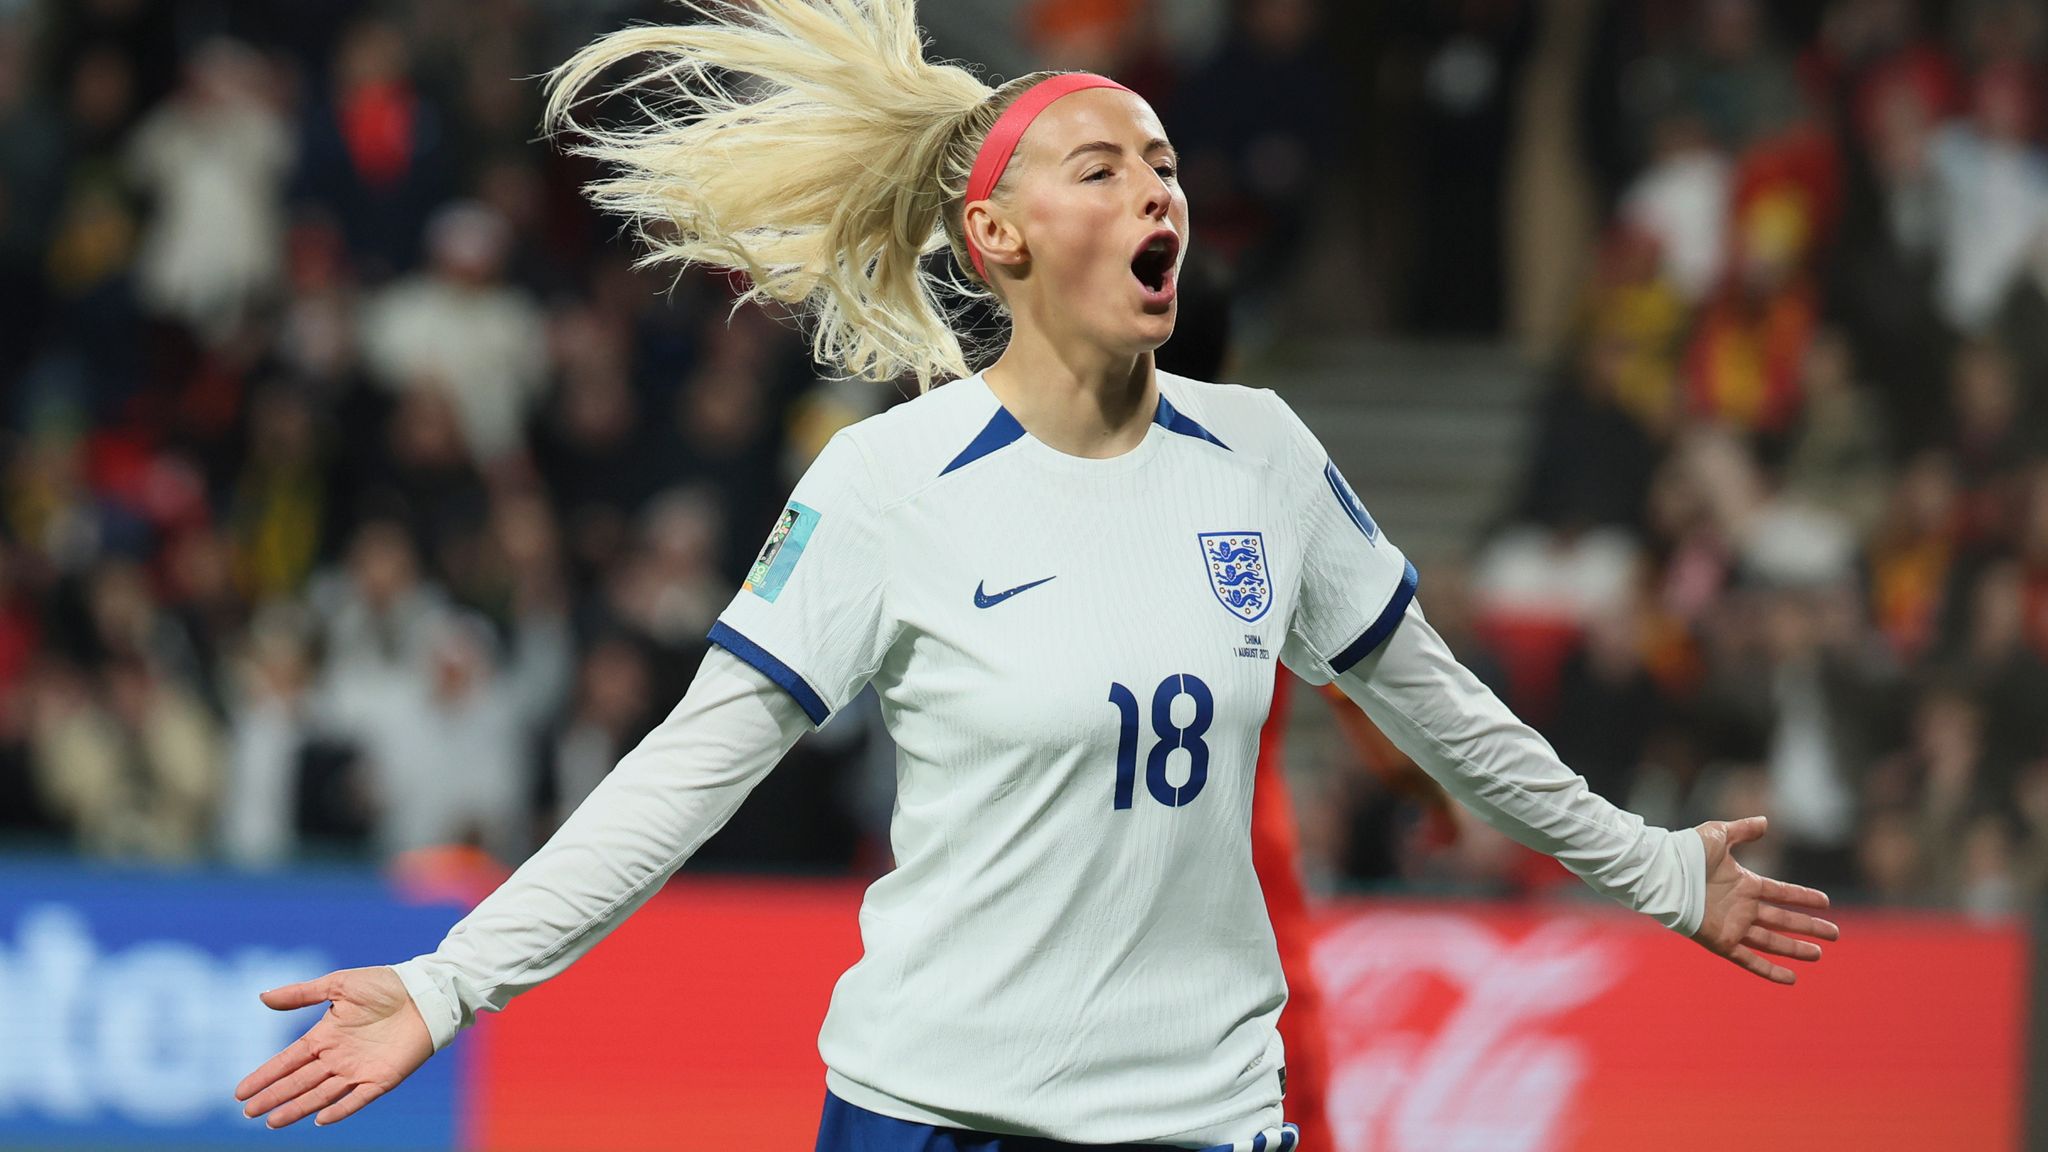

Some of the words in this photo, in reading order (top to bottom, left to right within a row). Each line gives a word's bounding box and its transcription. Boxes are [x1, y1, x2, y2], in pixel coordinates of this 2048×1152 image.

[1244, 634, 1262, 646] CHINA
[1239, 647, 1259, 659] AUGUST
[1108, 673, 1214, 811] 18
